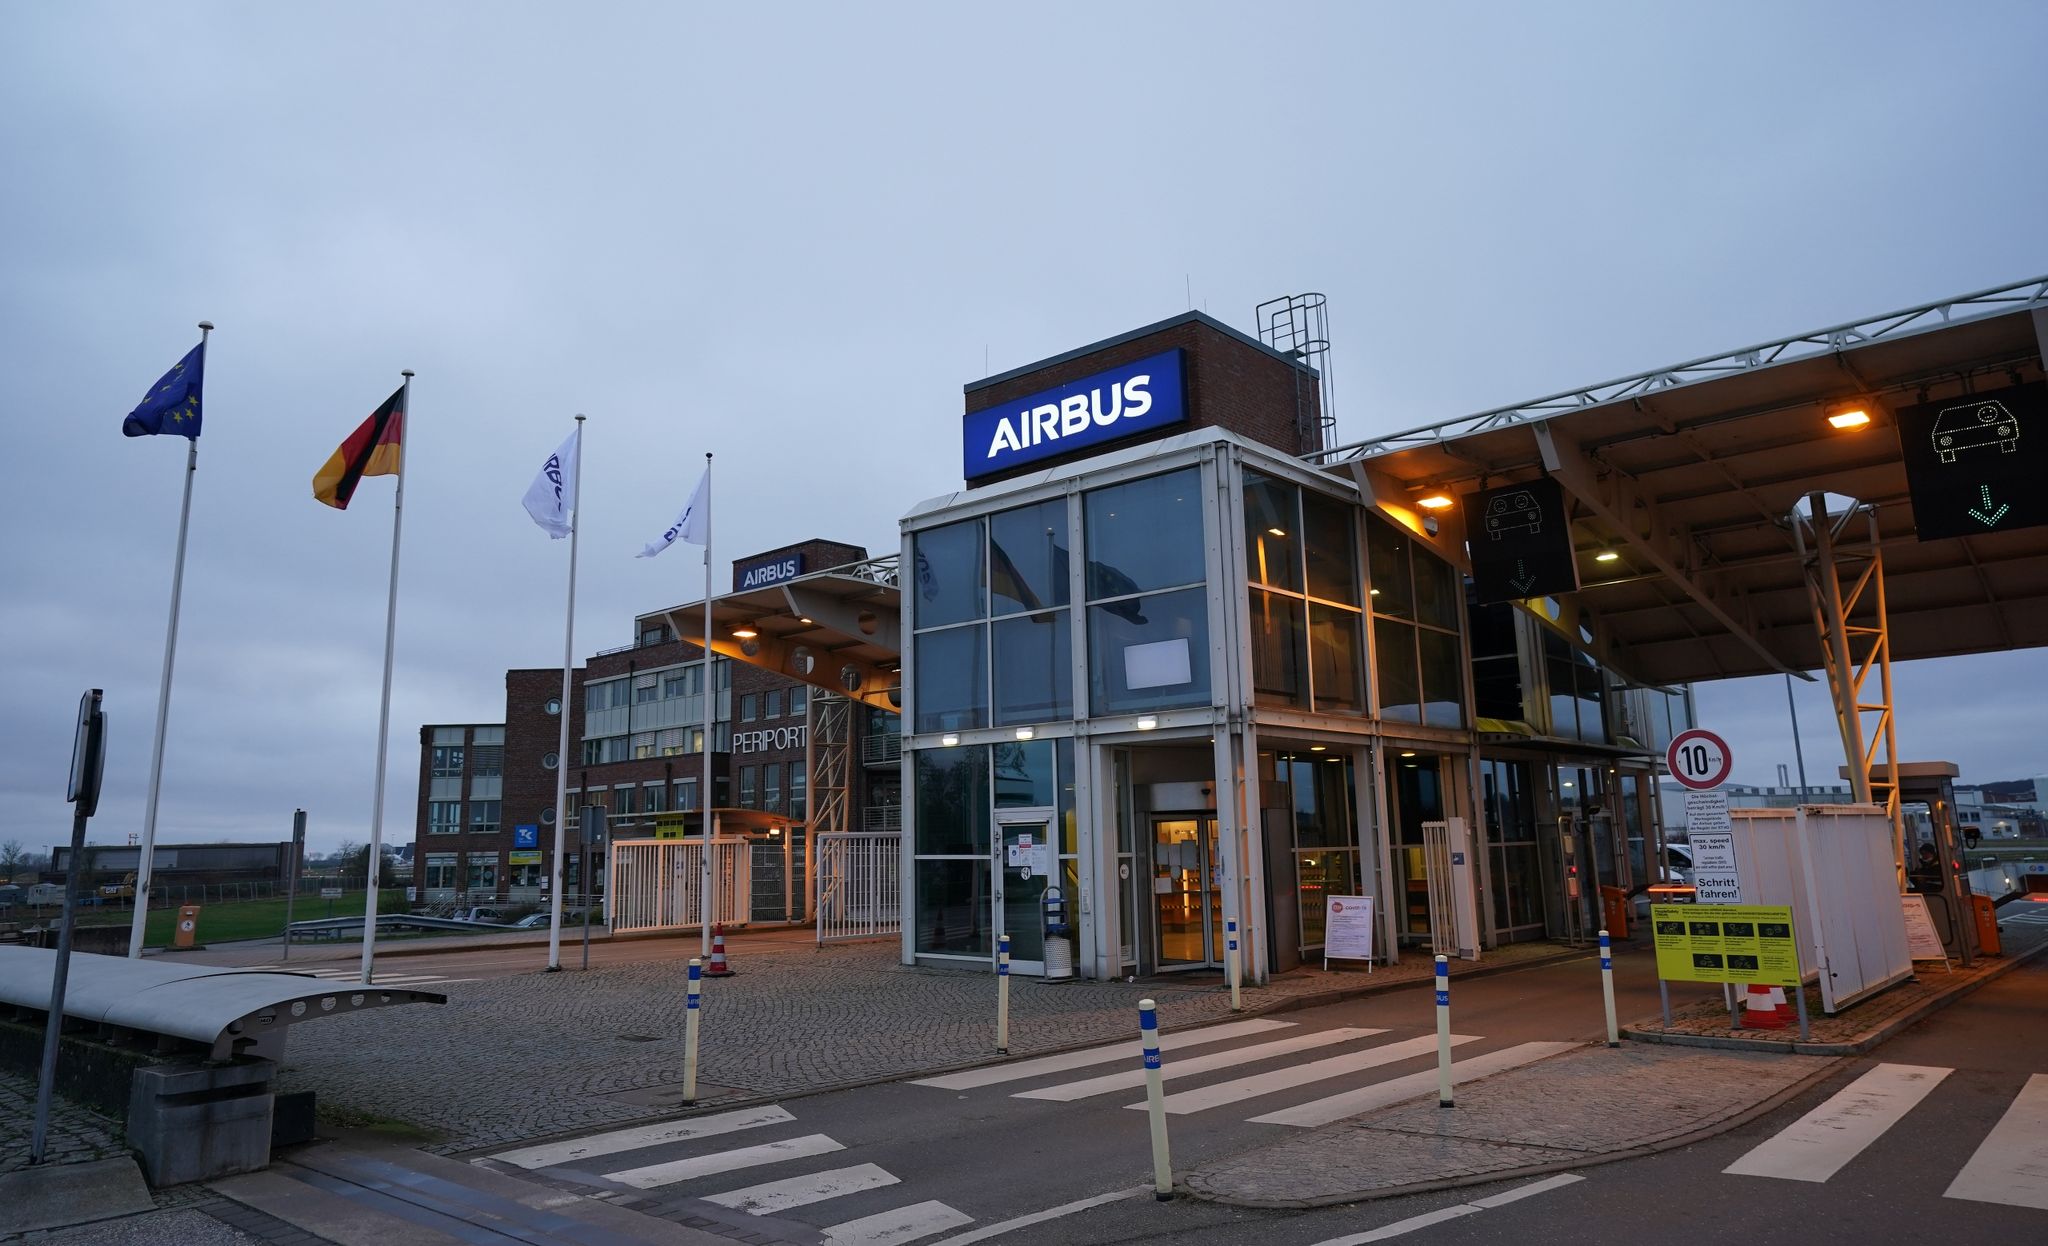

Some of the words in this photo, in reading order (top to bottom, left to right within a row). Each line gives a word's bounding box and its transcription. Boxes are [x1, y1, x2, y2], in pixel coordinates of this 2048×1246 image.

[987, 375, 1152, 458] AIRBUS
[743, 560, 795, 587] AIRBUS
[733, 725, 807, 754] PERIPORT
[1681, 745, 1708, 775] 10
[1698, 878, 1736, 887] Schritt
[1700, 889, 1738, 899] fahren!
